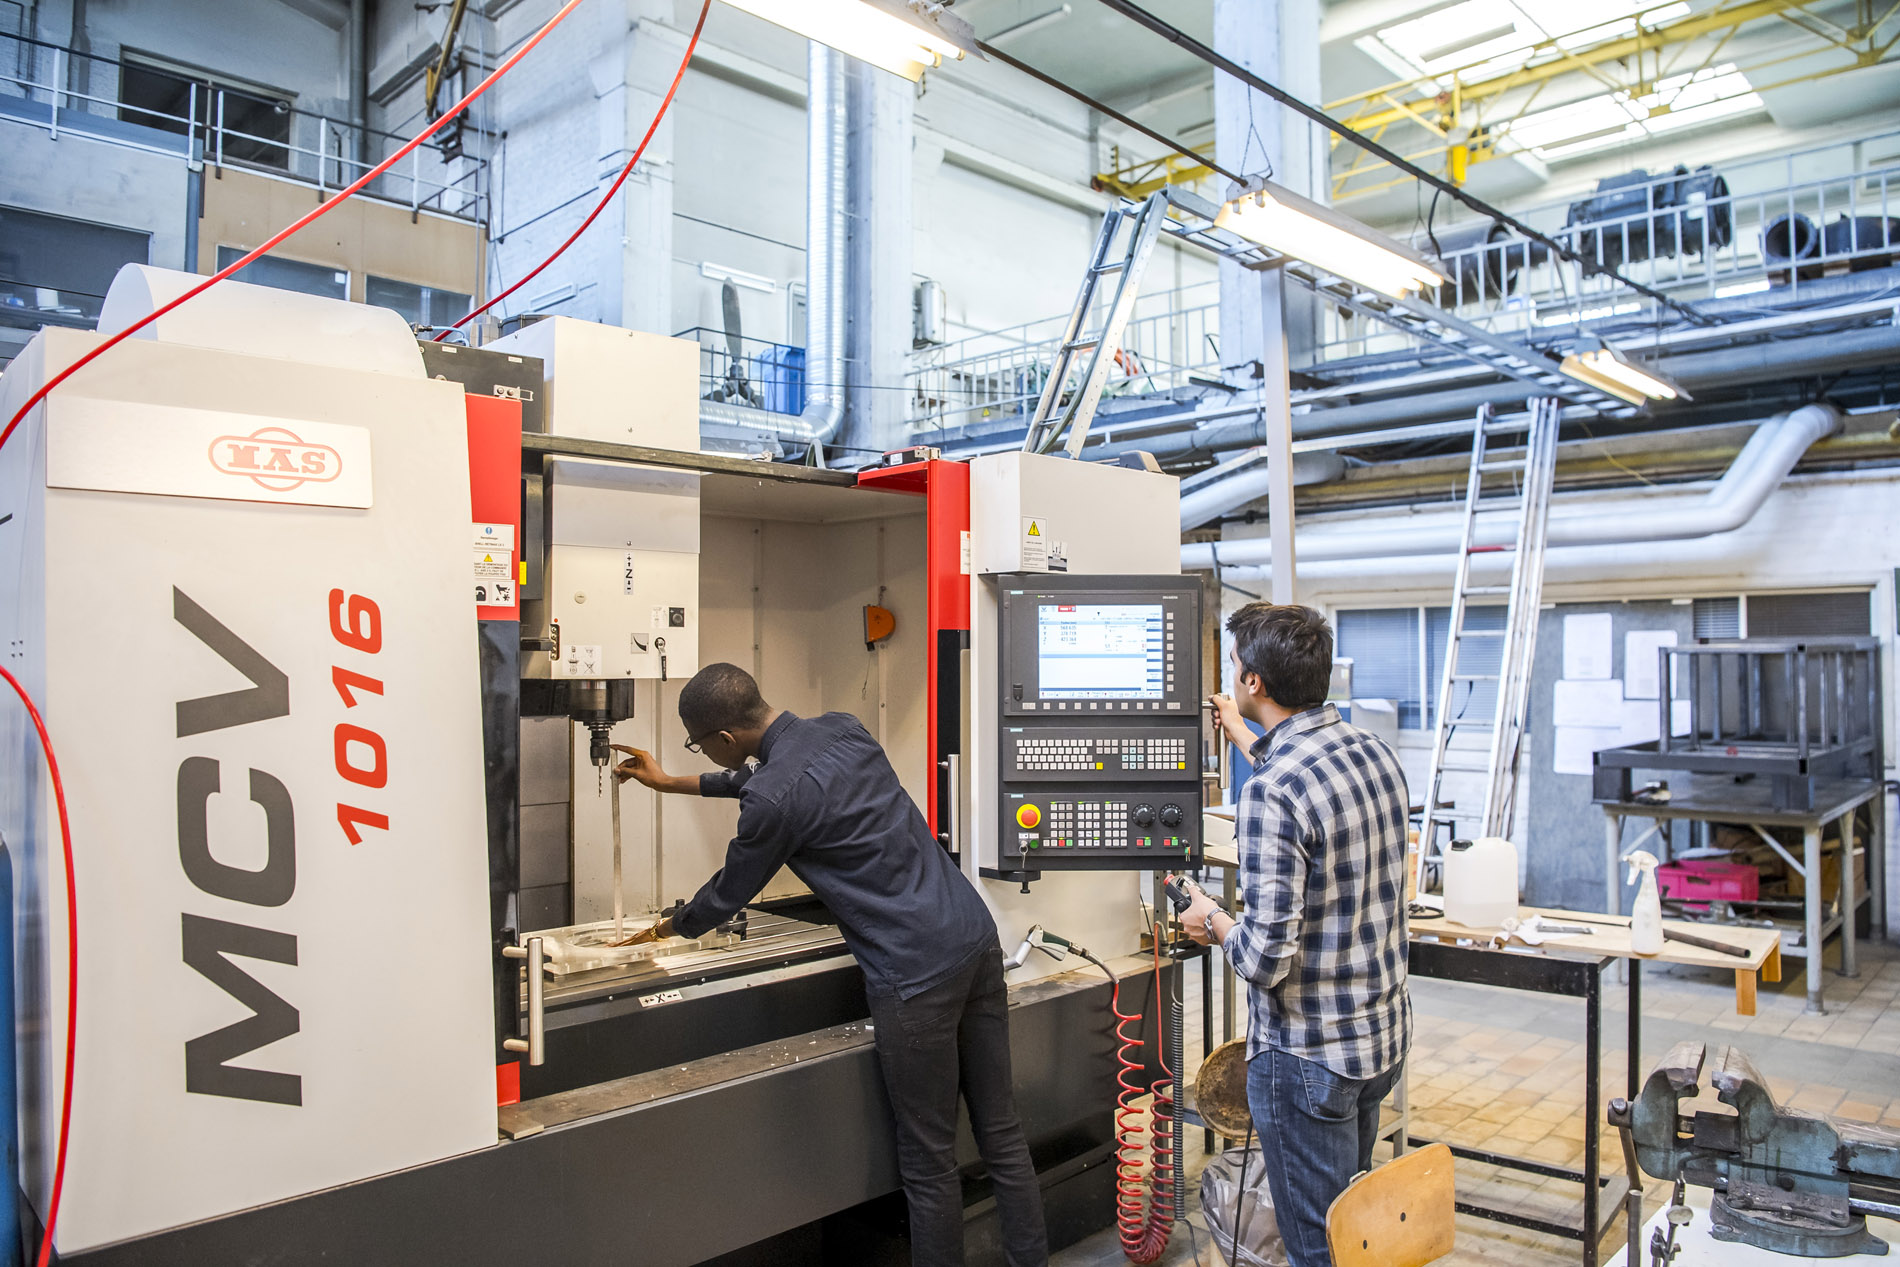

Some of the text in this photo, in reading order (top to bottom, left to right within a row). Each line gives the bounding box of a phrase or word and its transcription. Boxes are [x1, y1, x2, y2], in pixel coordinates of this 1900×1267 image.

[227, 443, 326, 475] MAS
[173, 585, 302, 1107] MCV
[329, 588, 389, 846] 1016
